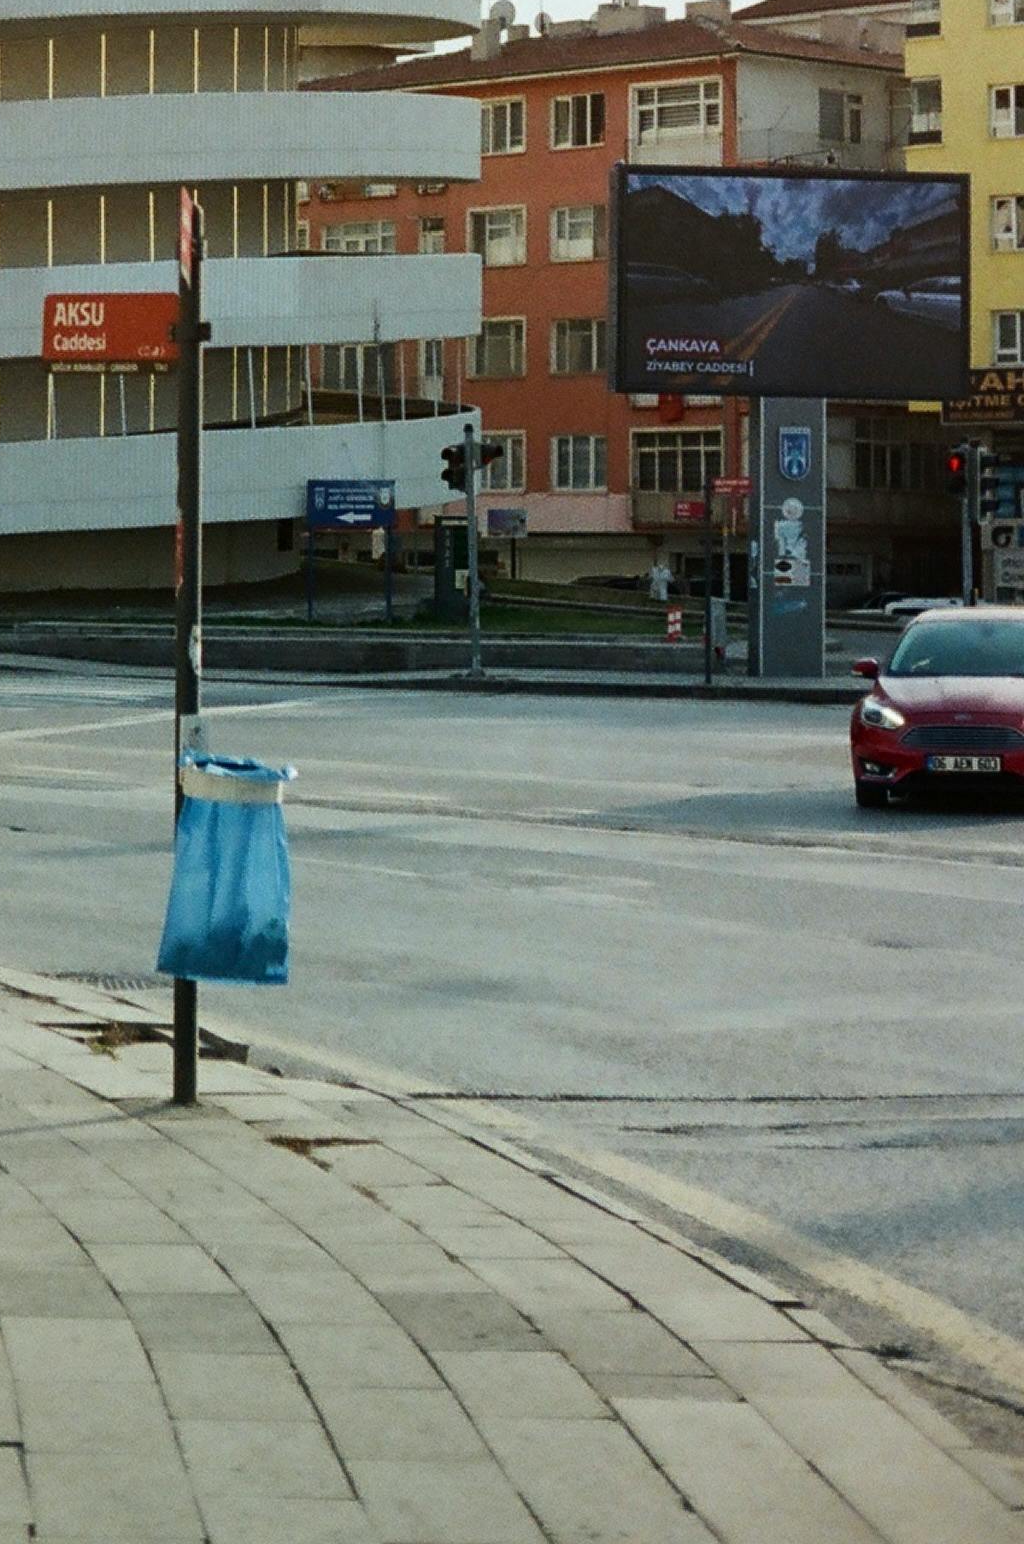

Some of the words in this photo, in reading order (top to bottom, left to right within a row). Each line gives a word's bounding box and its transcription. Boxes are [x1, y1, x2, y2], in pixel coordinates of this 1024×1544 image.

[54, 302, 104, 326] AKSU
[54, 333, 106, 351] Caddesi
[646, 338, 720, 354] ÇANKAYA
[646, 359, 694, 372] ZİYABEY
[696, 360, 747, 372] CADDESİ
